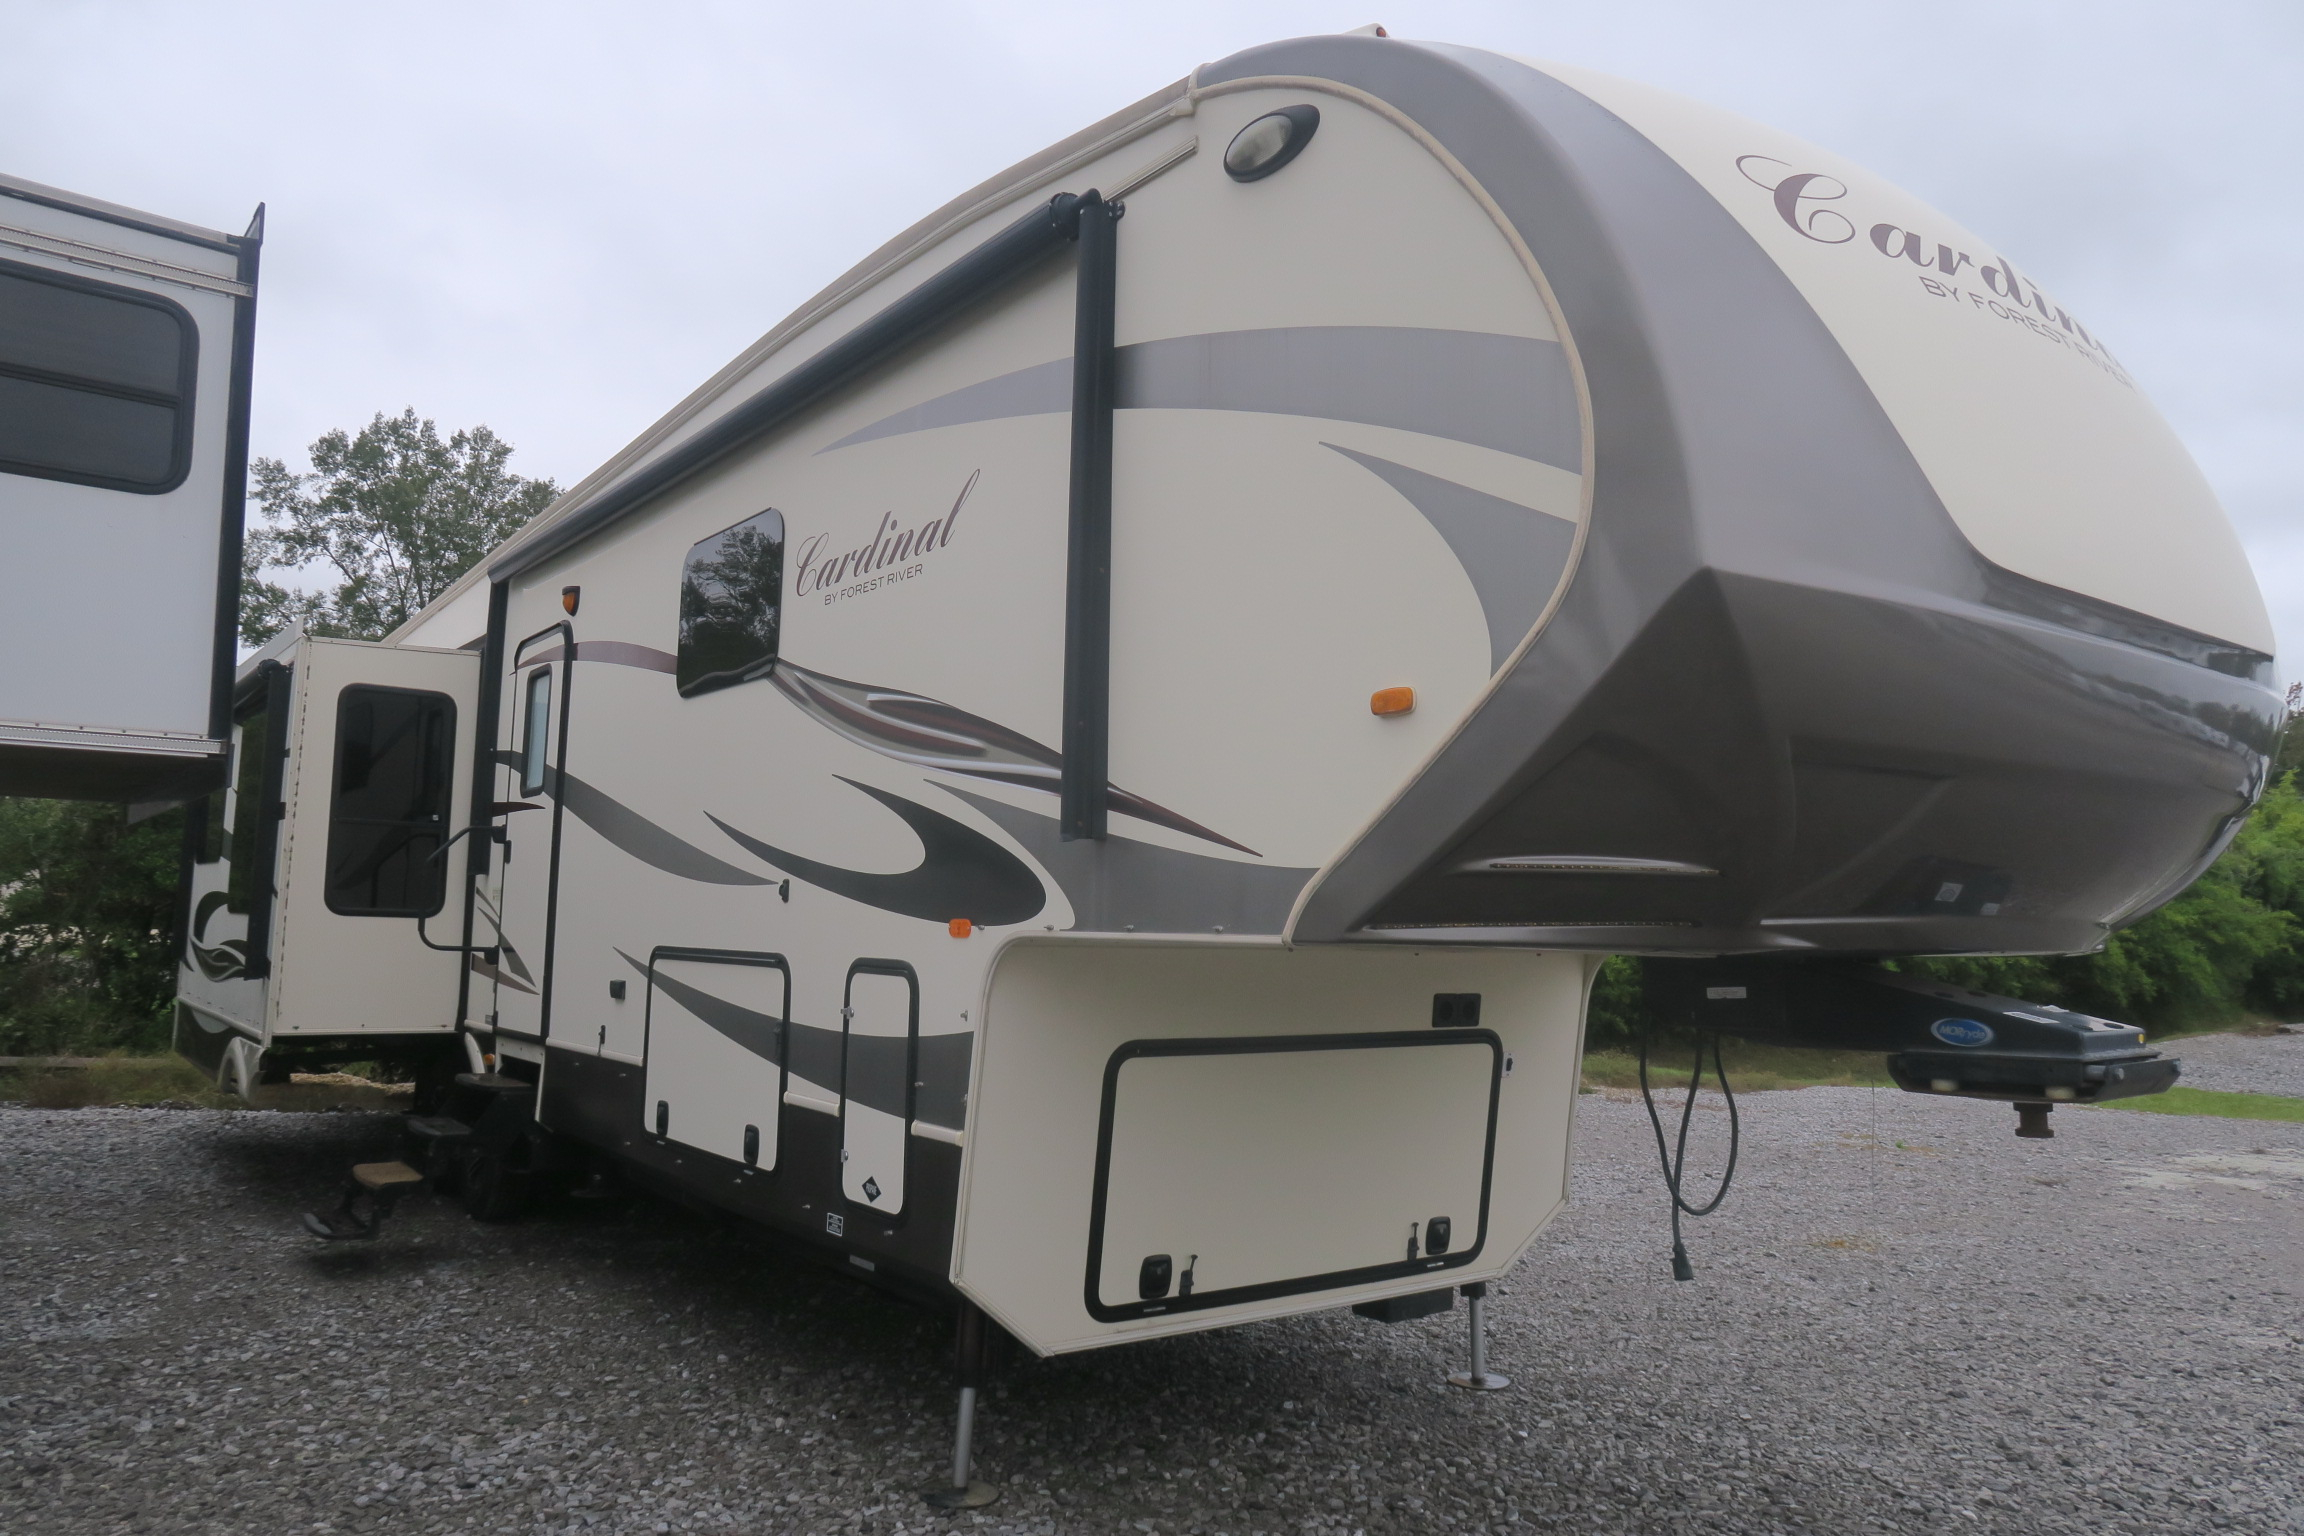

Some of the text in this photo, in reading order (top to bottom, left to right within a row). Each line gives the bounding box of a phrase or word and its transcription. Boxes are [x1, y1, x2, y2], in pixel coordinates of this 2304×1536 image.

[1918, 275, 1960, 302] BY
[1967, 291, 2071, 349] FOREST
[796, 468, 980, 597] Cardinal
[824, 563, 923, 606] BY FOREST RIVER
